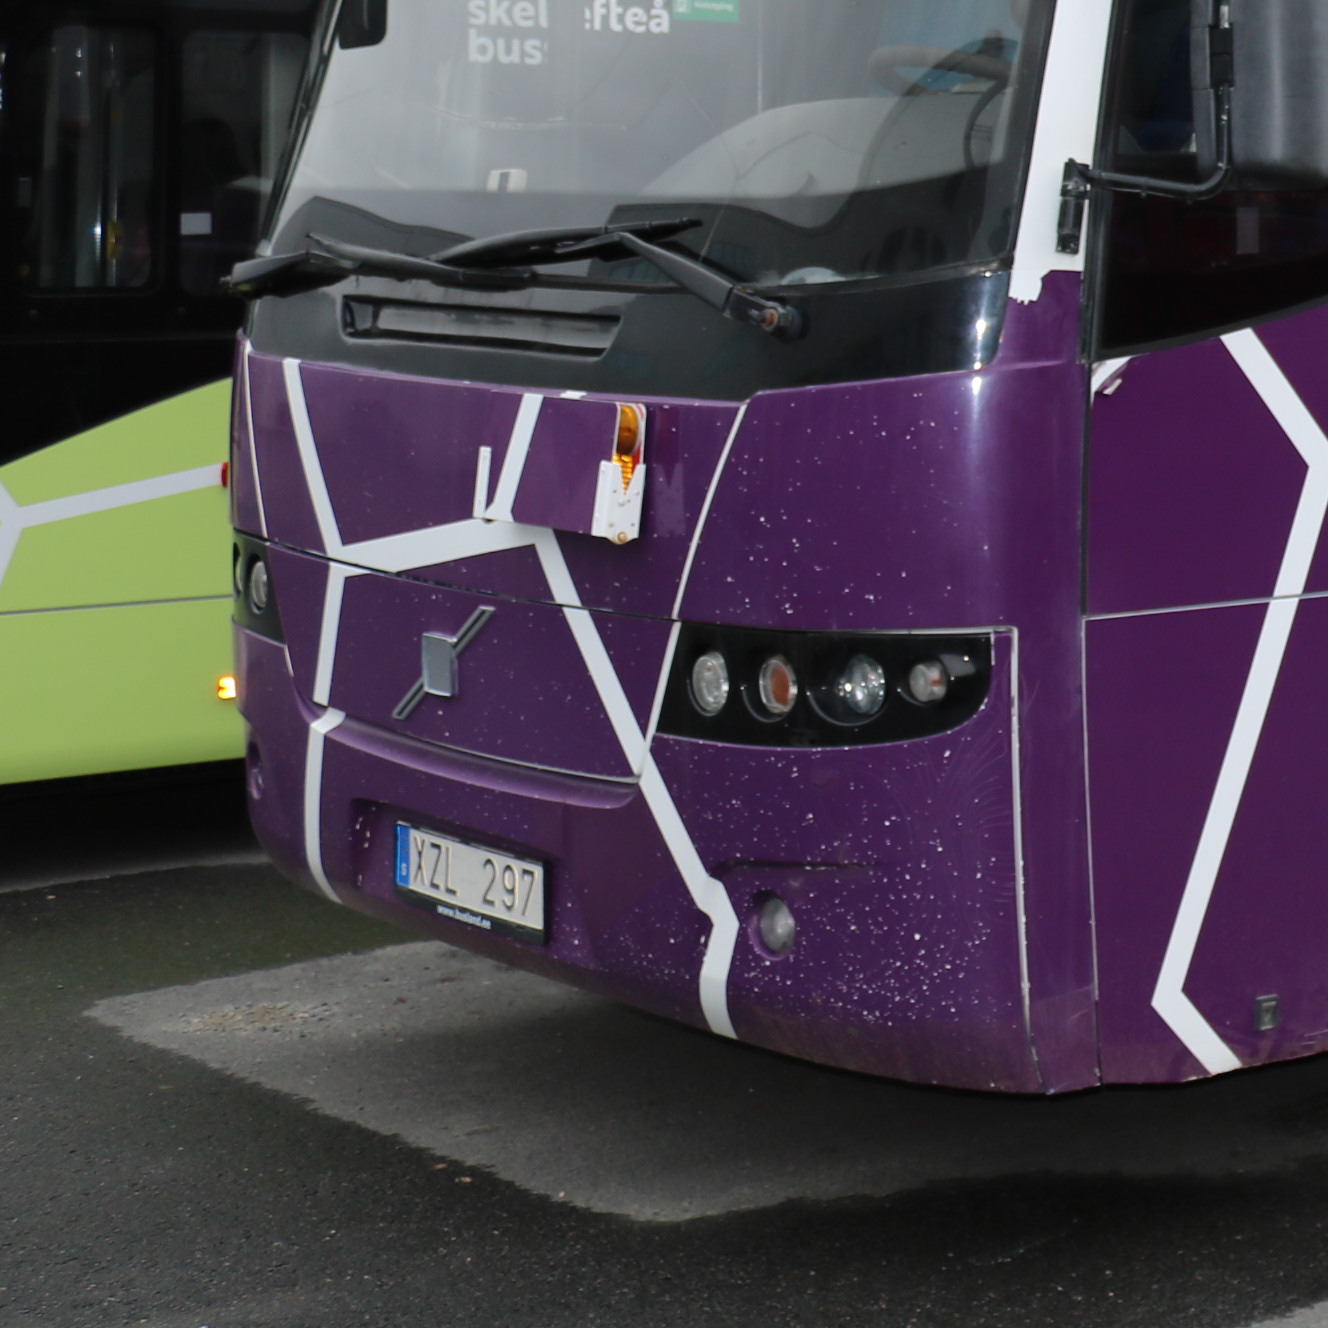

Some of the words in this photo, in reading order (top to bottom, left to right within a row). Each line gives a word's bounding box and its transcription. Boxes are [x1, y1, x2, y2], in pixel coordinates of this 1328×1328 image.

[467, 28, 549, 66] bus
[413, 834, 460, 897] XZL
[482, 857, 538, 917] 297
